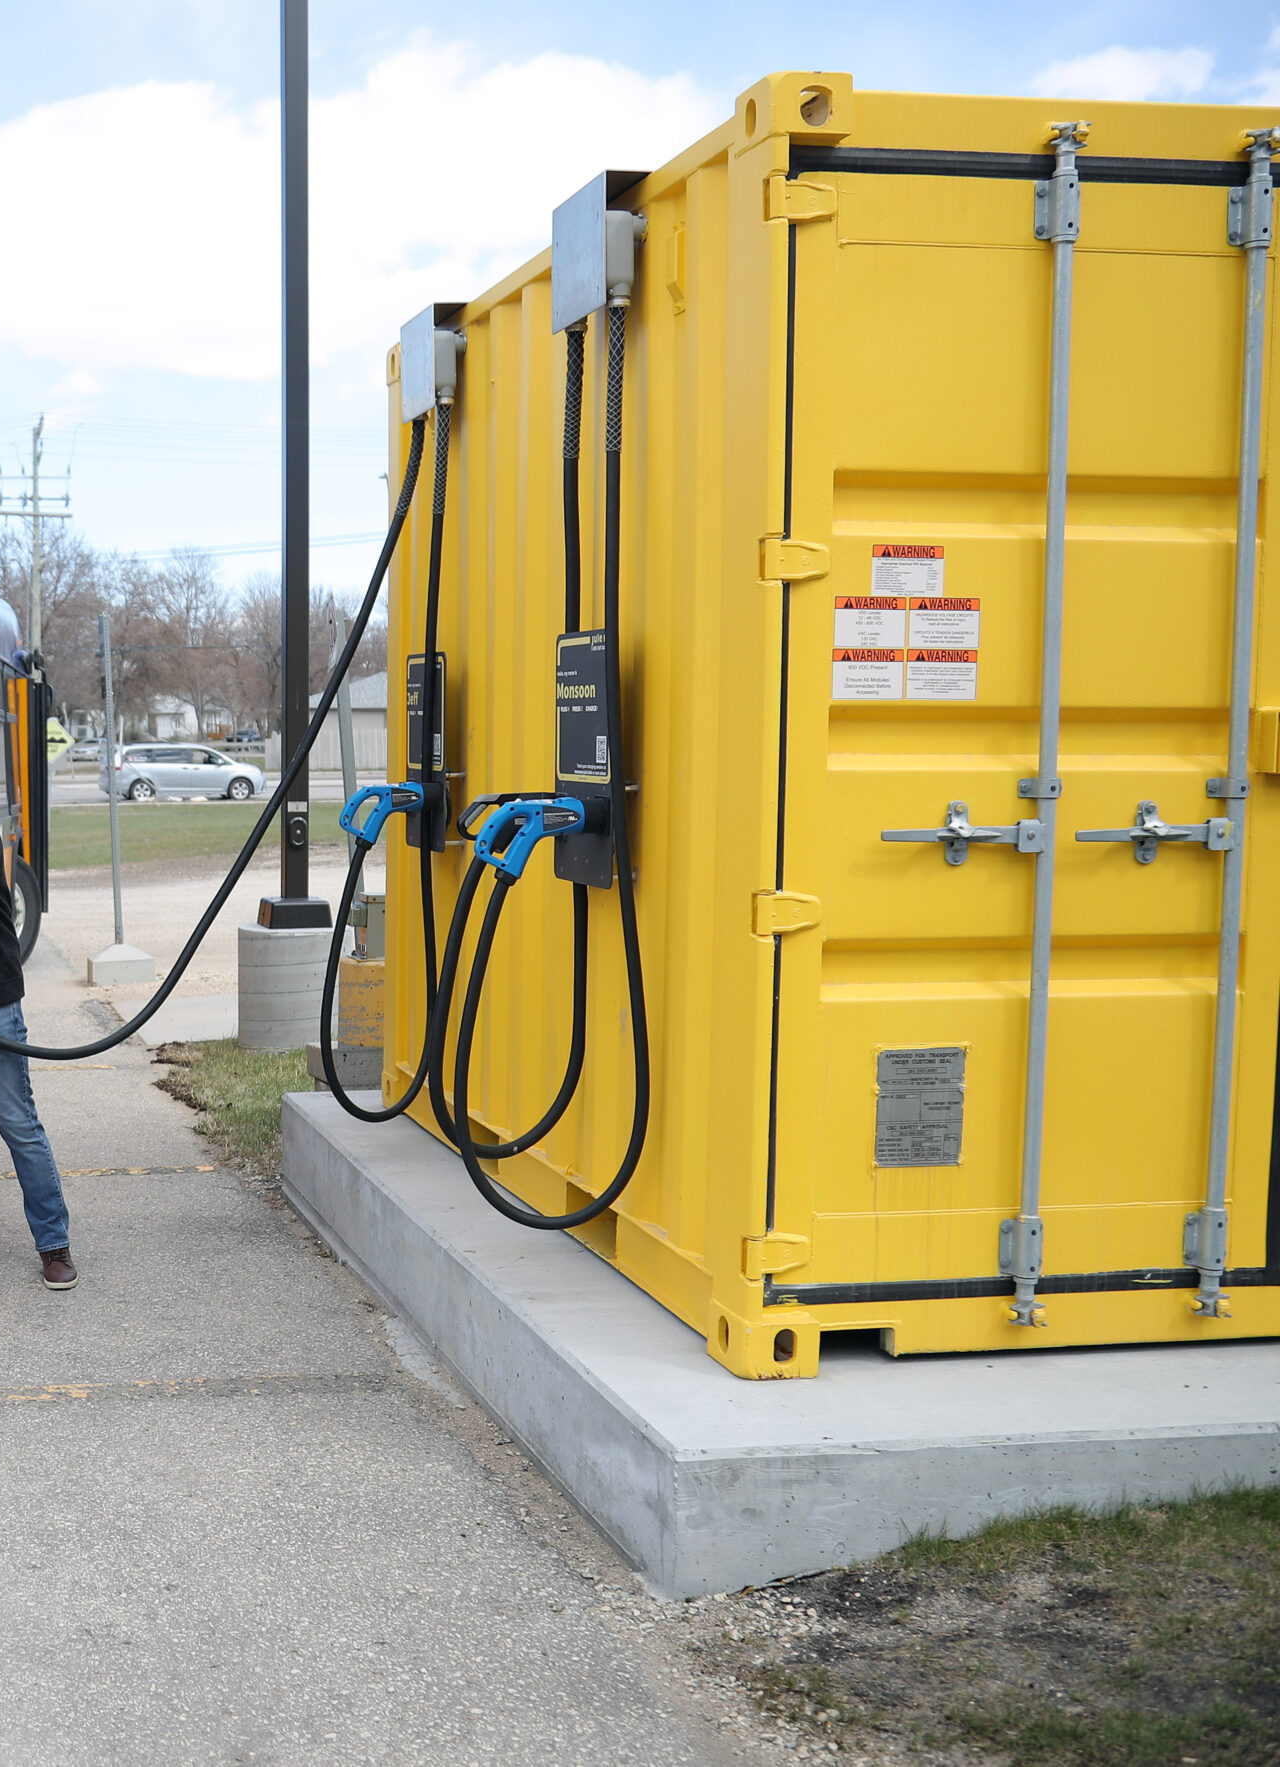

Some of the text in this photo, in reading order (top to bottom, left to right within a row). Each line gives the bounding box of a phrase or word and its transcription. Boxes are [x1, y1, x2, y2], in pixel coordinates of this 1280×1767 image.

[893, 546, 935, 558] WARNING
[855, 598, 898, 609] WARNING
[929, 599, 972, 610] WARNING
[591, 633, 602, 646] jule
[852, 650, 895, 661] WARNING
[926, 651, 969, 662] WARNING
[557, 682, 596, 699] Monsoon
